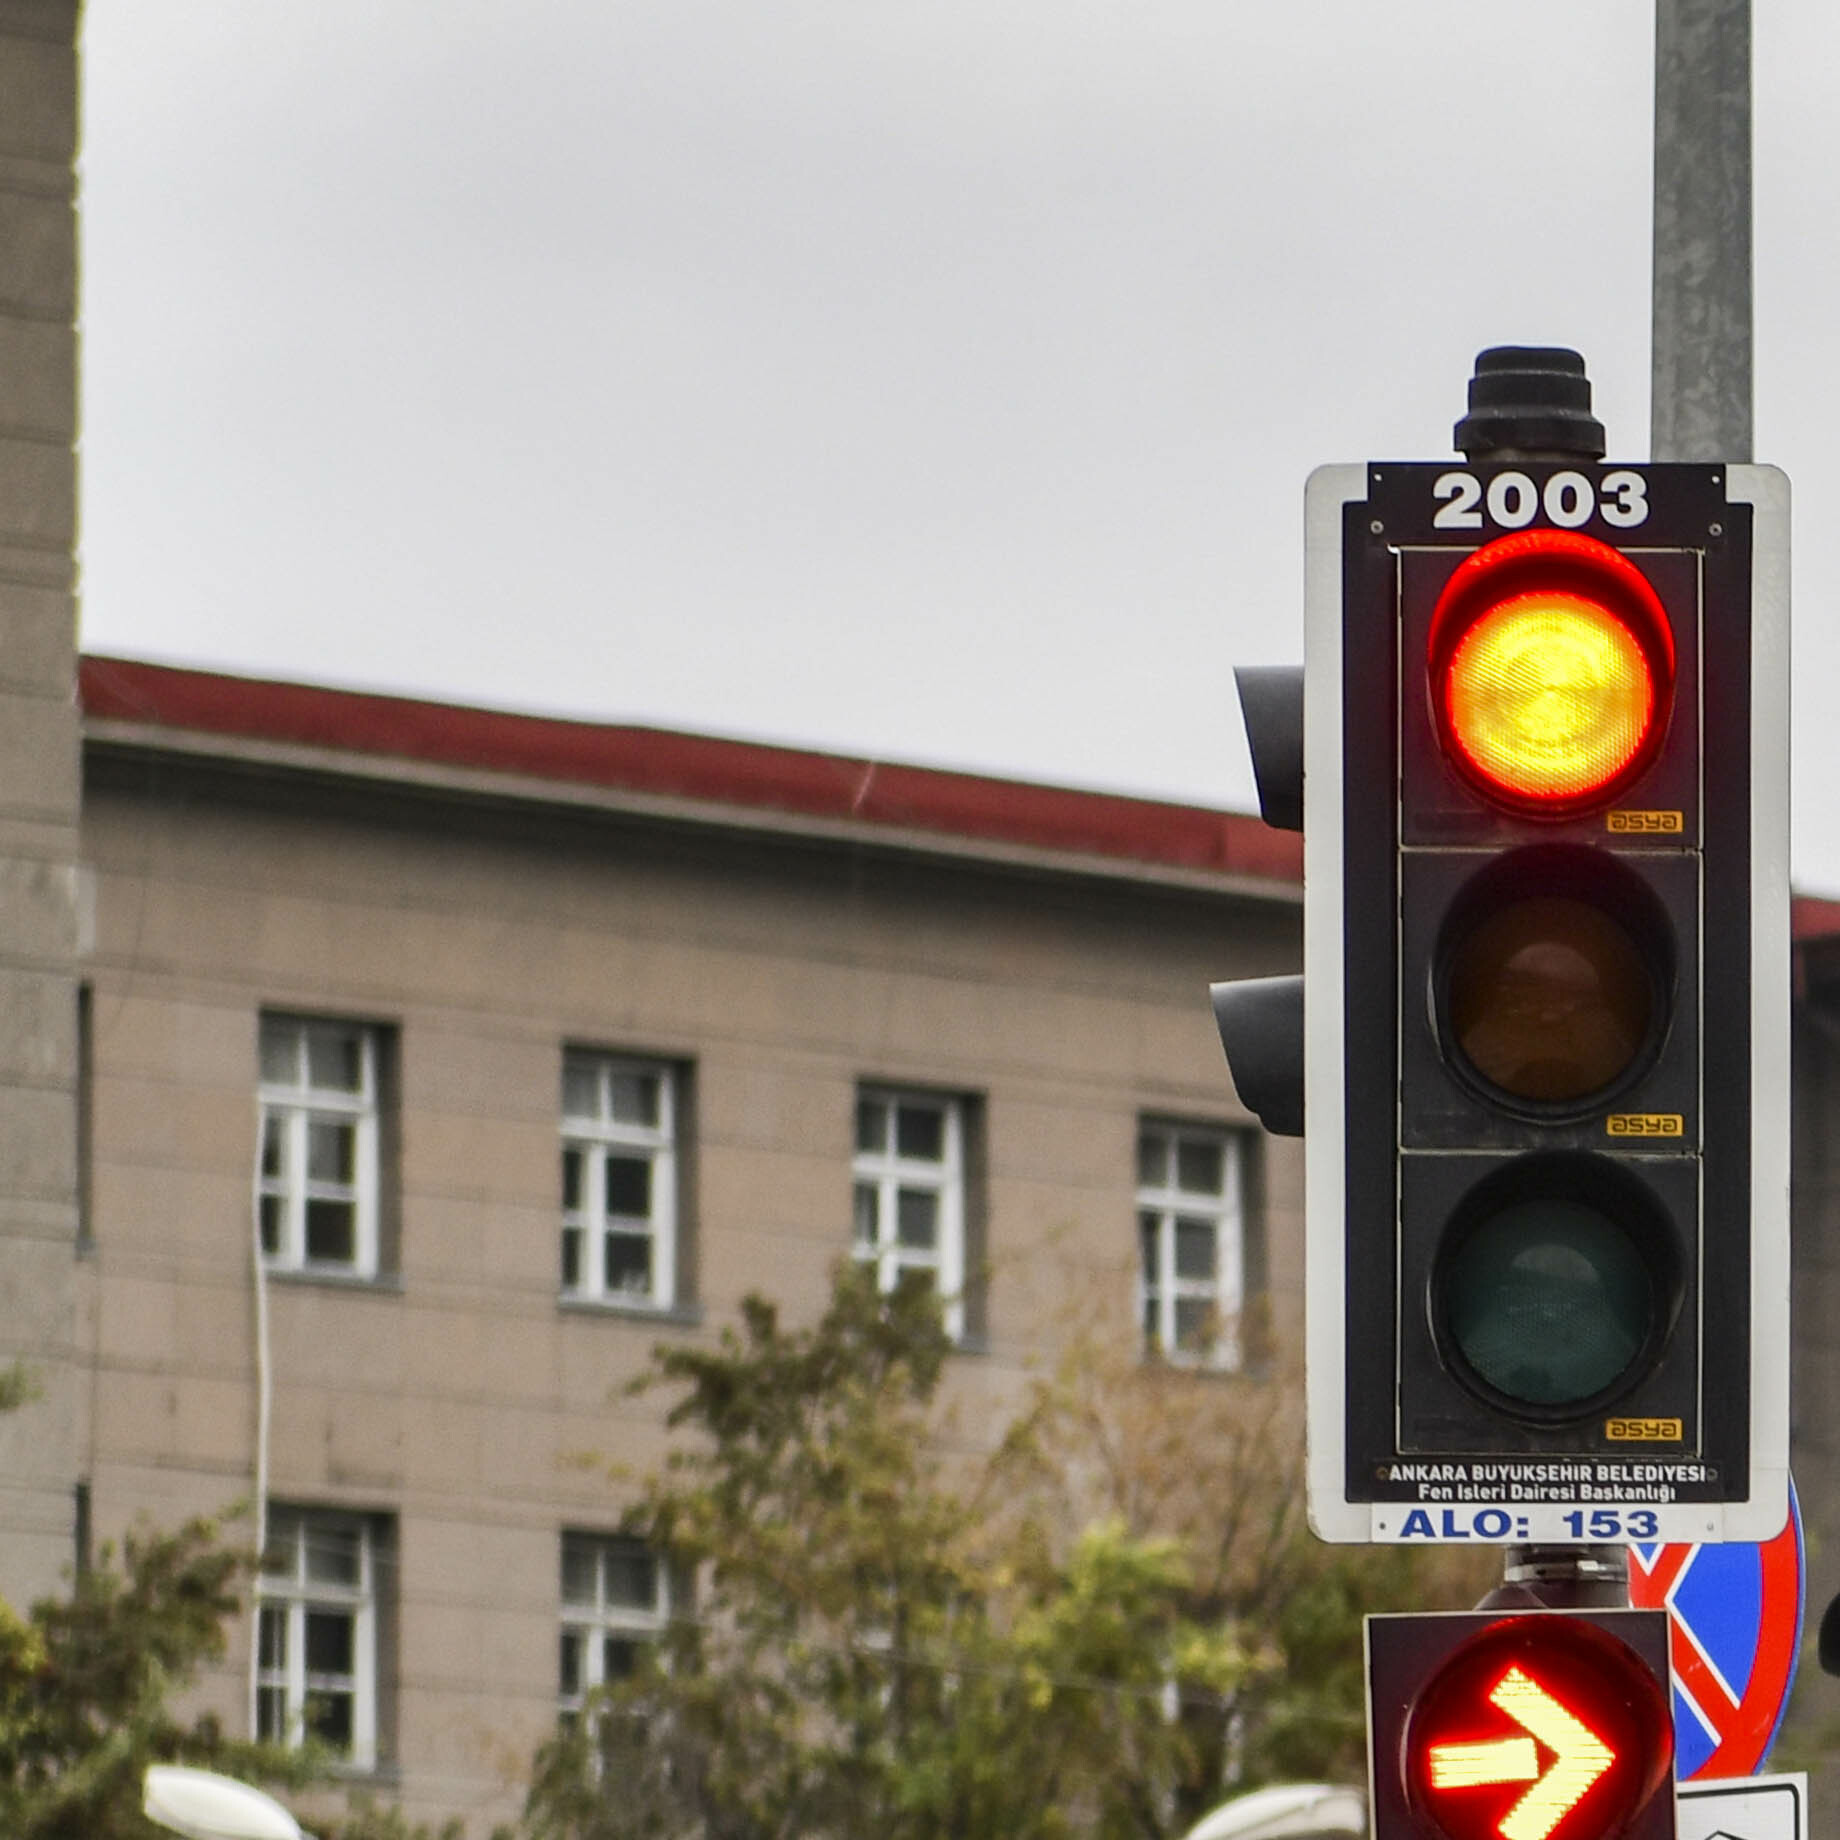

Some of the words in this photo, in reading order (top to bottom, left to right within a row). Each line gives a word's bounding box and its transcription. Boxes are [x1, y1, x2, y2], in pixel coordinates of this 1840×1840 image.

[1433, 471, 1649, 528] 2003
[1612, 814, 1677, 829] asya
[1612, 1117, 1677, 1132] asya
[1612, 1421, 1677, 1437] asya
[1389, 1464, 1467, 1481] ANKARA
[1418, 1483, 1453, 1500] Fen
[1511, 1484, 1575, 1500] Dairesi
[1400, 1509, 1529, 1538] ALO:
[1562, 1510, 1659, 1538] 153
